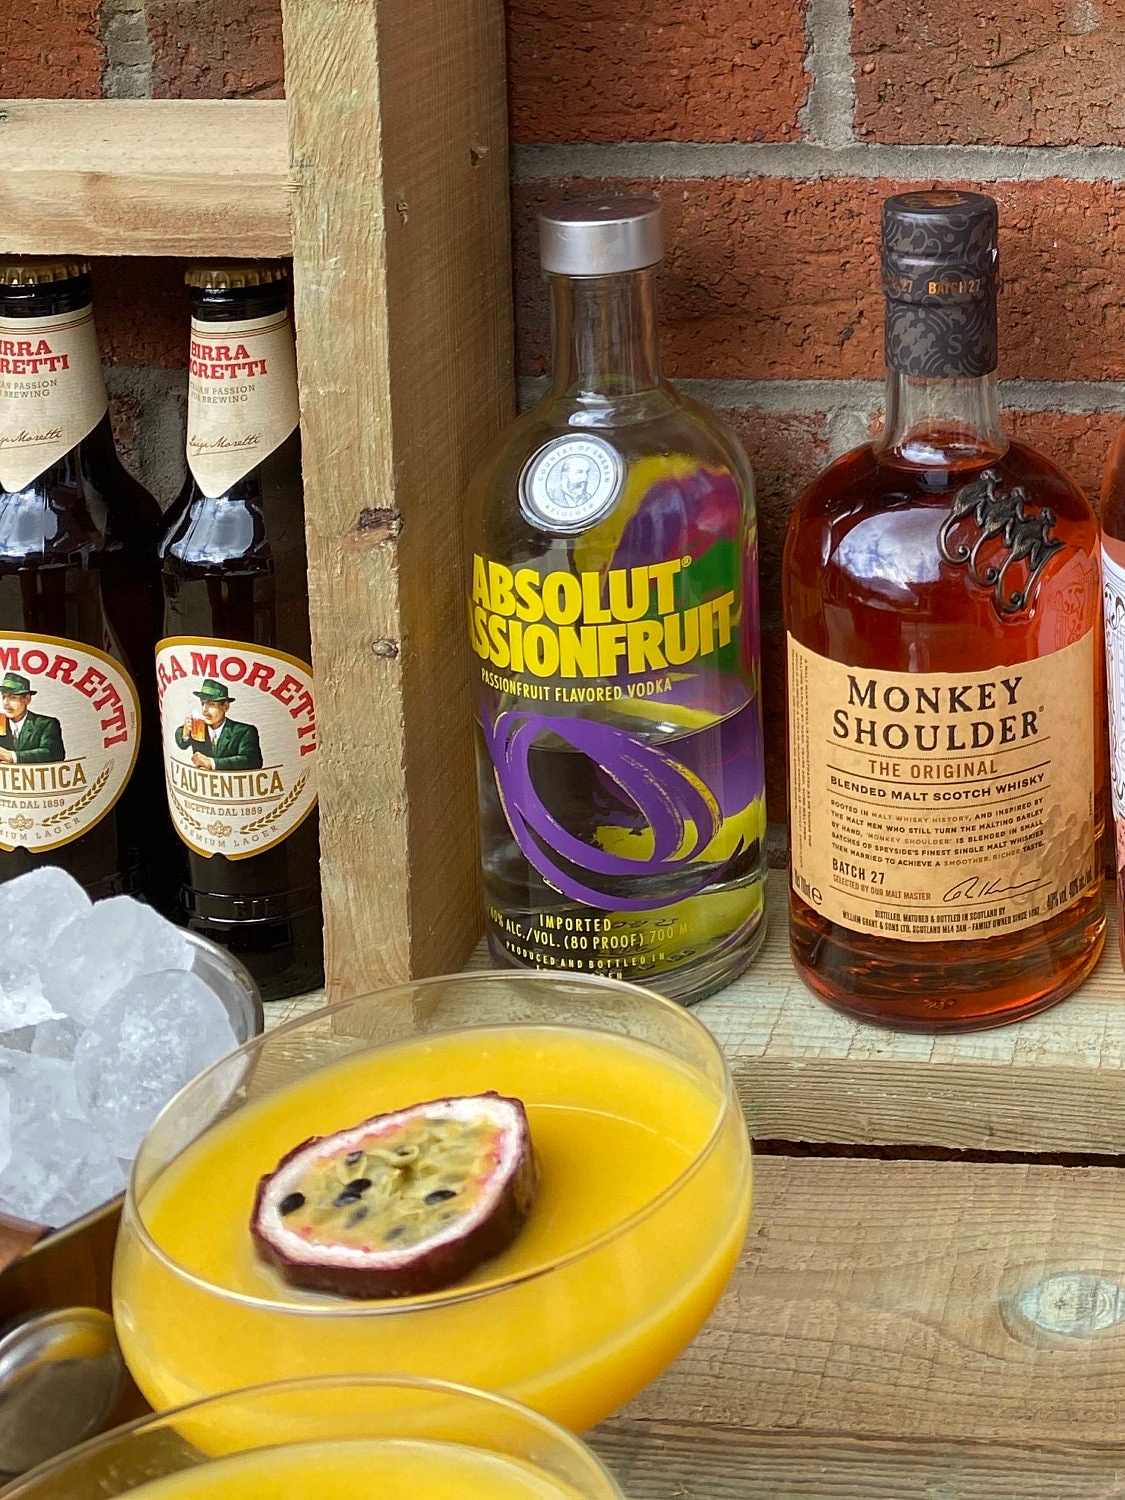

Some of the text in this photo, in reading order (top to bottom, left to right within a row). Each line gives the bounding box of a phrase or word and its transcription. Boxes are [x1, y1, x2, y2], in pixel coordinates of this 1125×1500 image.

[928, 279, 980, 294] BATCH 27
[0, 340, 52, 356] RRA
[4, 389, 50, 398] BREWING
[14, 379, 57, 390] PASSION
[212, 384, 255, 395] PASSION
[202, 395, 248, 403] BREWING
[468, 590, 734, 678] SSIONFRUIT
[481, 667, 672, 702] PASSIONFRUIT FLAVORED VODKA
[847, 675, 1023, 714] MONKEY
[833, 709, 1039, 751] SHOULDER
[171, 760, 284, 799] L'AUTENTICA
[868, 759, 998, 779] THE ORIGINAL
[830, 773, 1044, 801] BLENDED MALT SCOTCH WHISKY
[218, 806, 237, 816] DAL
[831, 799, 858, 814] ROOTED
[932, 815, 971, 823] HISTORY,
[975, 812, 992, 820] AND
[996, 801, 1031, 817] INSPIRED
[1035, 797, 1043, 806] BY
[831, 810, 843, 820] THE
[846, 816, 864, 826] MALT
[886, 825, 905, 833] WHO
[979, 818, 1013, 830] MALTING
[1016, 808, 1044, 822] BARLEY
[36, 817, 80, 839] LAGER
[234, 825, 279, 847] LAGER
[841, 823, 863, 837] HAND,
[968, 831, 1005, 843] BLENDED
[1009, 827, 1017, 835] IN
[1020, 820, 1043, 832] SMALL
[832, 832, 860, 847] BATCHES
[954, 844, 984, 855] SINGLE
[987, 840, 1007, 851] MALT
[1010, 829, 1044, 846] WHISKIES
[832, 842, 848, 853] THEN
[850, 850, 882, 863] MARRIED
[885, 857, 896, 865] TO
[993, 848, 1020, 860] RICHER
[833, 858, 885, 885] BATCH 27
[833, 874, 931, 900] SELECTED BY OUR MALT MASTER
[506, 918, 673, 949] ALC./VOL. (80 PROOF) 700
[540, 914, 611, 932] IMPORTED
[505, 941, 555, 965] PRODUCED
[560, 958, 583, 969] AND
[589, 956, 645, 968] BOTTLED
[652, 952, 665, 962] IN
